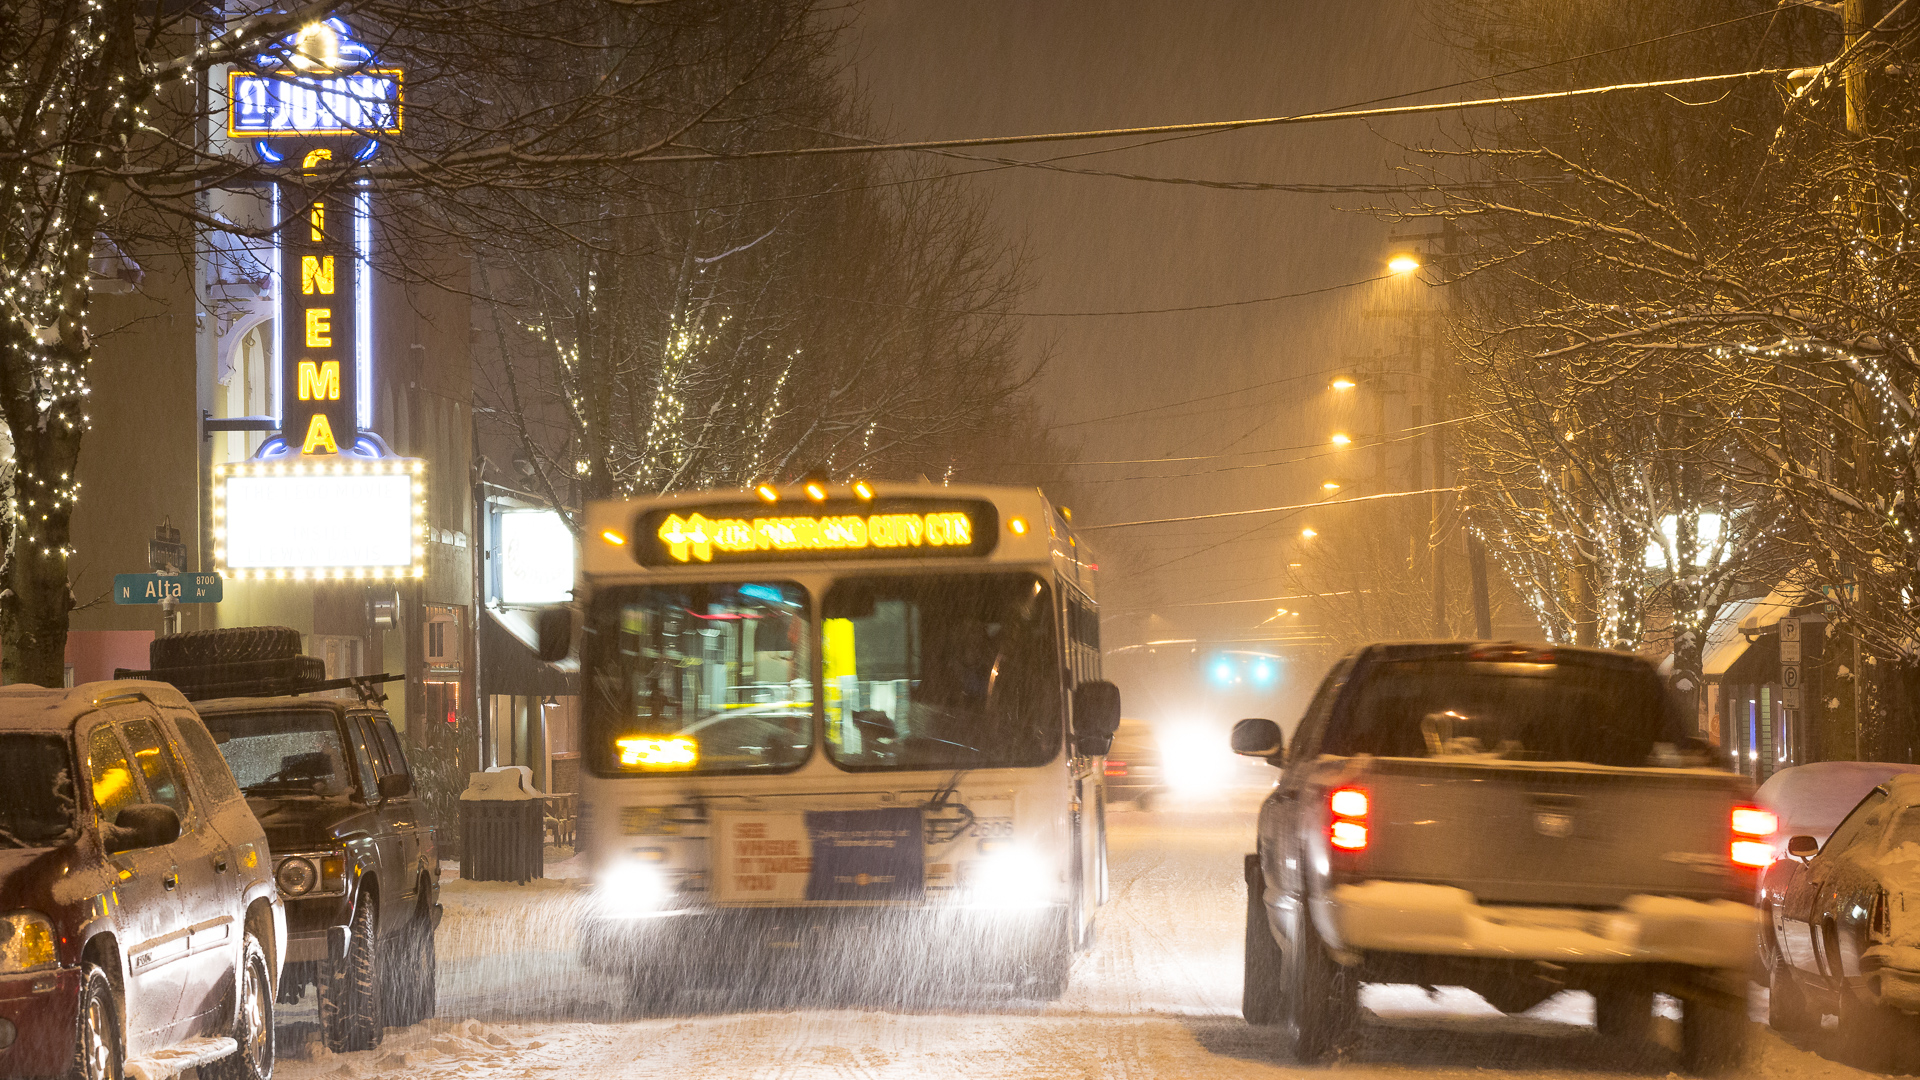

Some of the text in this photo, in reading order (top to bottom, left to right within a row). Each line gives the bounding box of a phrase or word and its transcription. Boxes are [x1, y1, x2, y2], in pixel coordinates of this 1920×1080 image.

[241, 482, 392, 501] THE LEGO MOVIE
[658, 512, 713, 562] 44
[868, 514, 923, 547] CITY
[123, 579, 206, 598] N Alta Av
[196, 575, 215, 585] 8700
